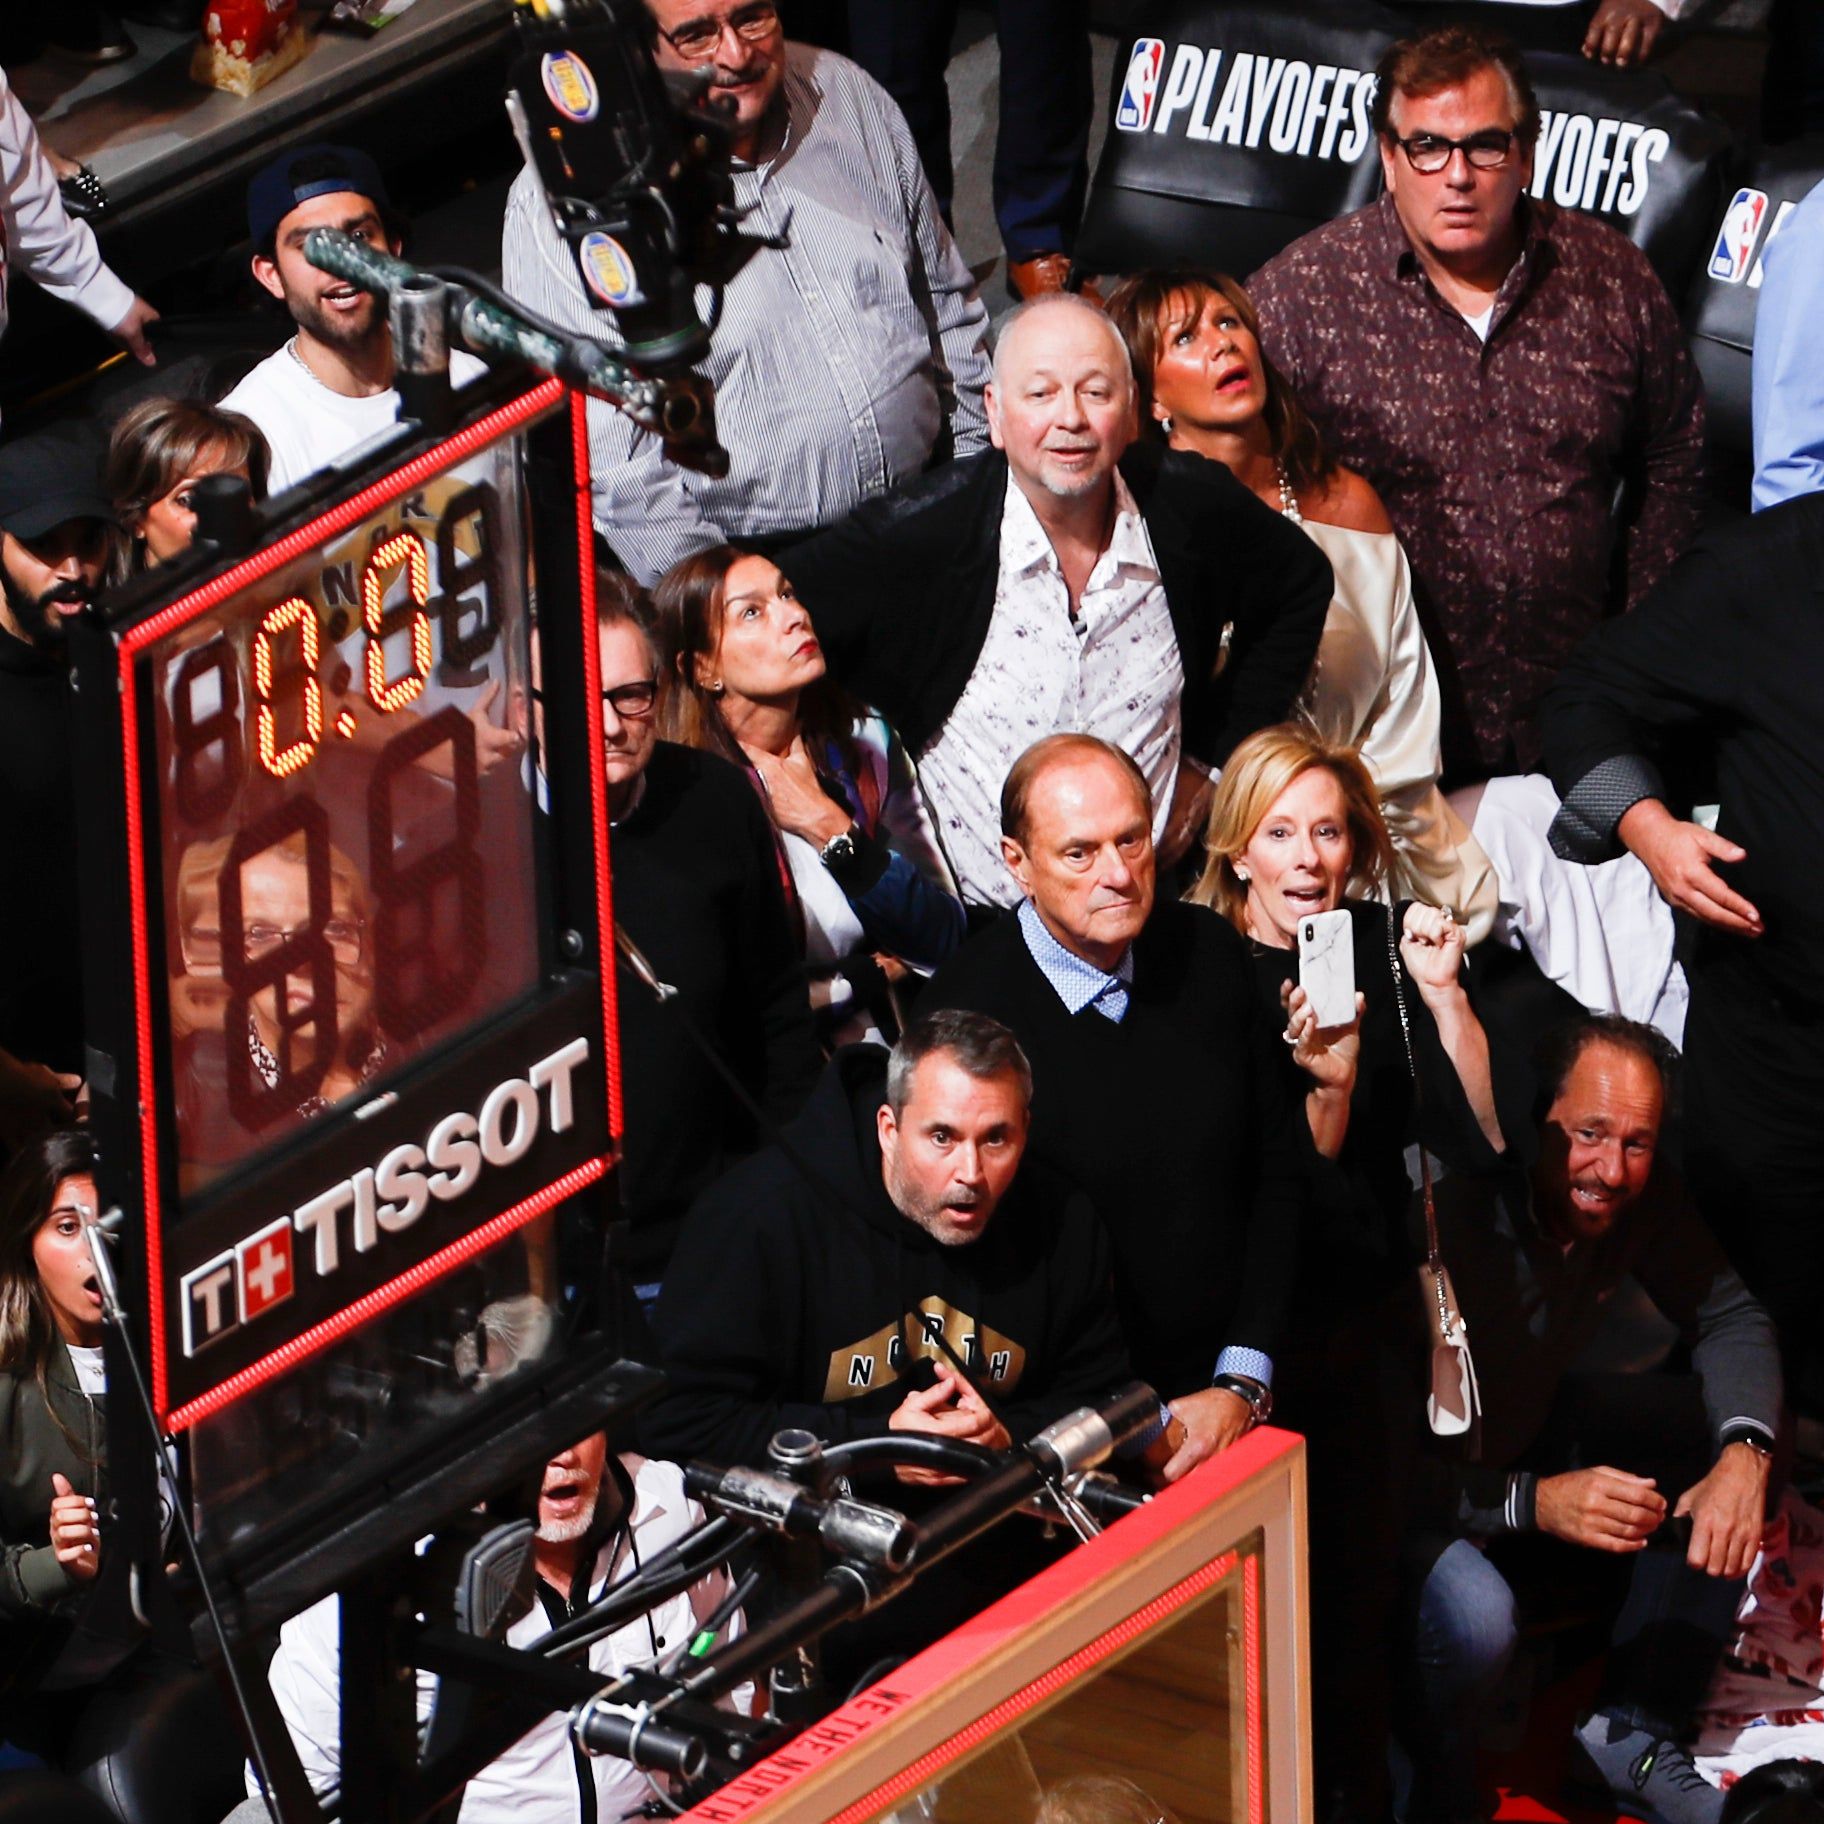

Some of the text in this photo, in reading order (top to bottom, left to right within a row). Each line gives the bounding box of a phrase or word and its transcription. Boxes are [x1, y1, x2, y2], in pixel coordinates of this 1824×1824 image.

[1153, 43, 1378, 163] PLAYOFFS
[1530, 109, 1670, 216] YOFFS
[294, 1036, 590, 1277] TISSOT
[695, 1688, 912, 1823] WE THE NORTH
